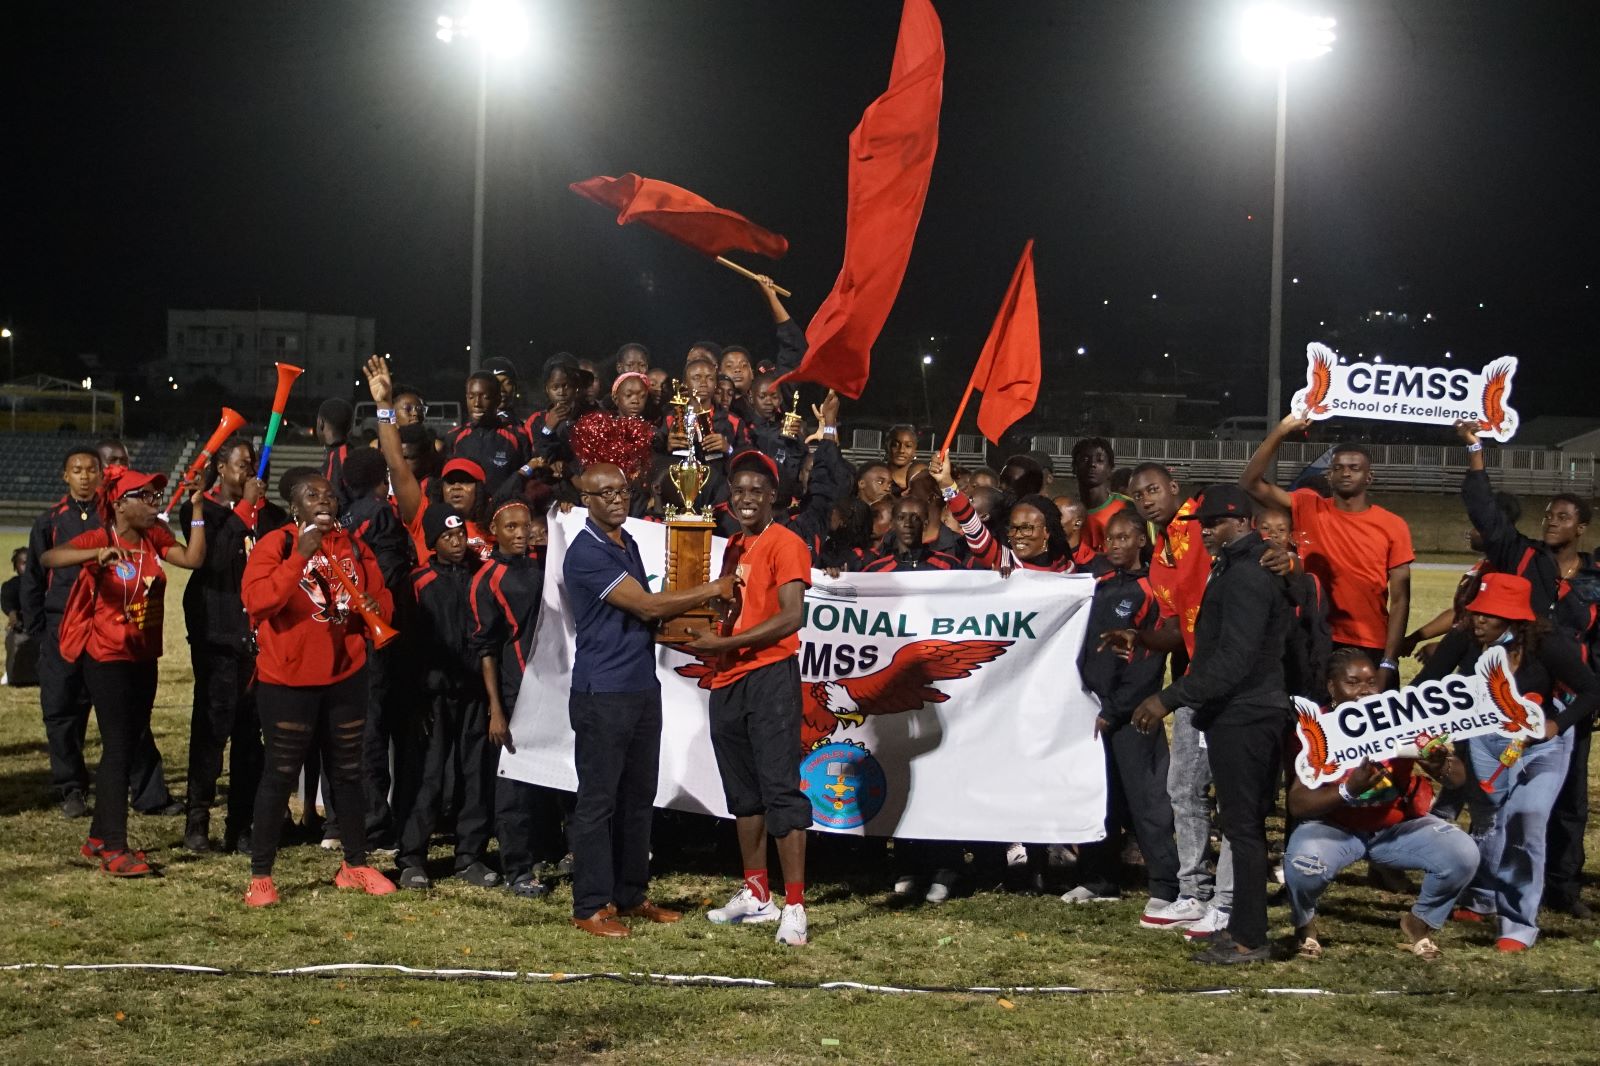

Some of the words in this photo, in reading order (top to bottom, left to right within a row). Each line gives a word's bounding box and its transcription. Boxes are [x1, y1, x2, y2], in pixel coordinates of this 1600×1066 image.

[1347, 368, 1469, 402] CEMSS
[1332, 398, 1379, 412] School
[1384, 402, 1398, 414] of
[1401, 404, 1478, 420] Excellence
[802, 601, 917, 638] IONAL
[931, 611, 1038, 640] BANK
[800, 641, 878, 677] MSS
[1338, 680, 1474, 738] CEMSS
[1334, 740, 1381, 763] HOME
[1440, 712, 1499, 735] EAGLES
